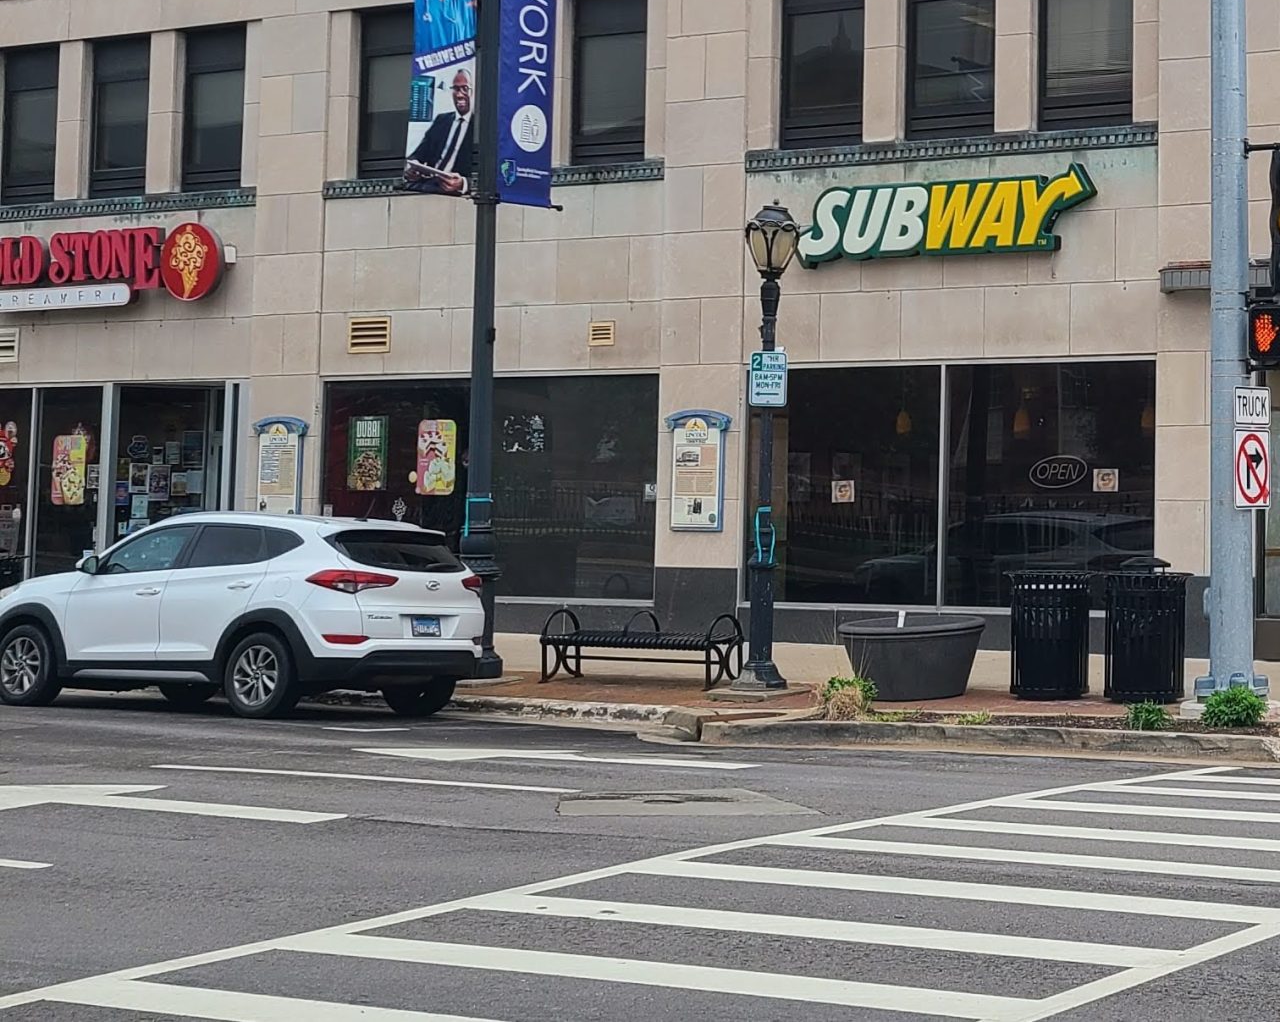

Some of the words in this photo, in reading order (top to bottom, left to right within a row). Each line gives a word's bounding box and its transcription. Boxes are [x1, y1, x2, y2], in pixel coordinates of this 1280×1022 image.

[415, 48, 456, 70] THRIVE
[799, 170, 1083, 261] SUBWAY
[0, 236, 43, 286] LD
[49, 227, 159, 291] STONE
[753, 355, 761, 368] 2
[756, 381, 781, 389] MON-FRI
[1237, 395, 1267, 417] TRUCK
[356, 420, 380, 438] DUBAI
[1036, 463, 1081, 480] OPEN
